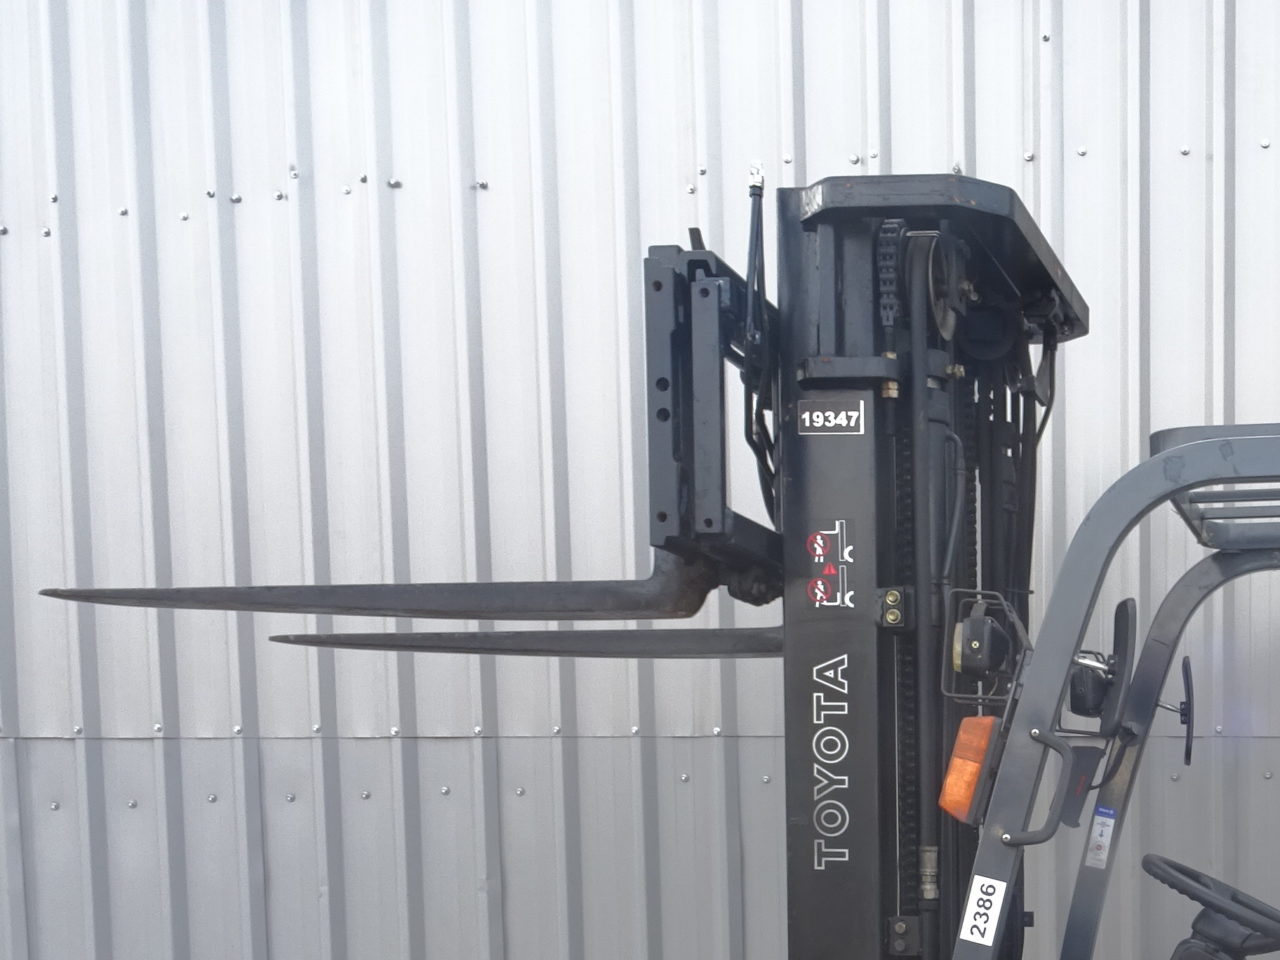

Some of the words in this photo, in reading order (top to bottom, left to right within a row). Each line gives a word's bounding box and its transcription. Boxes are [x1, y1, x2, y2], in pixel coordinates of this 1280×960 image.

[801, 410, 860, 428] 19347
[812, 653, 849, 870] TOYOTA
[969, 882, 997, 939] 2386
